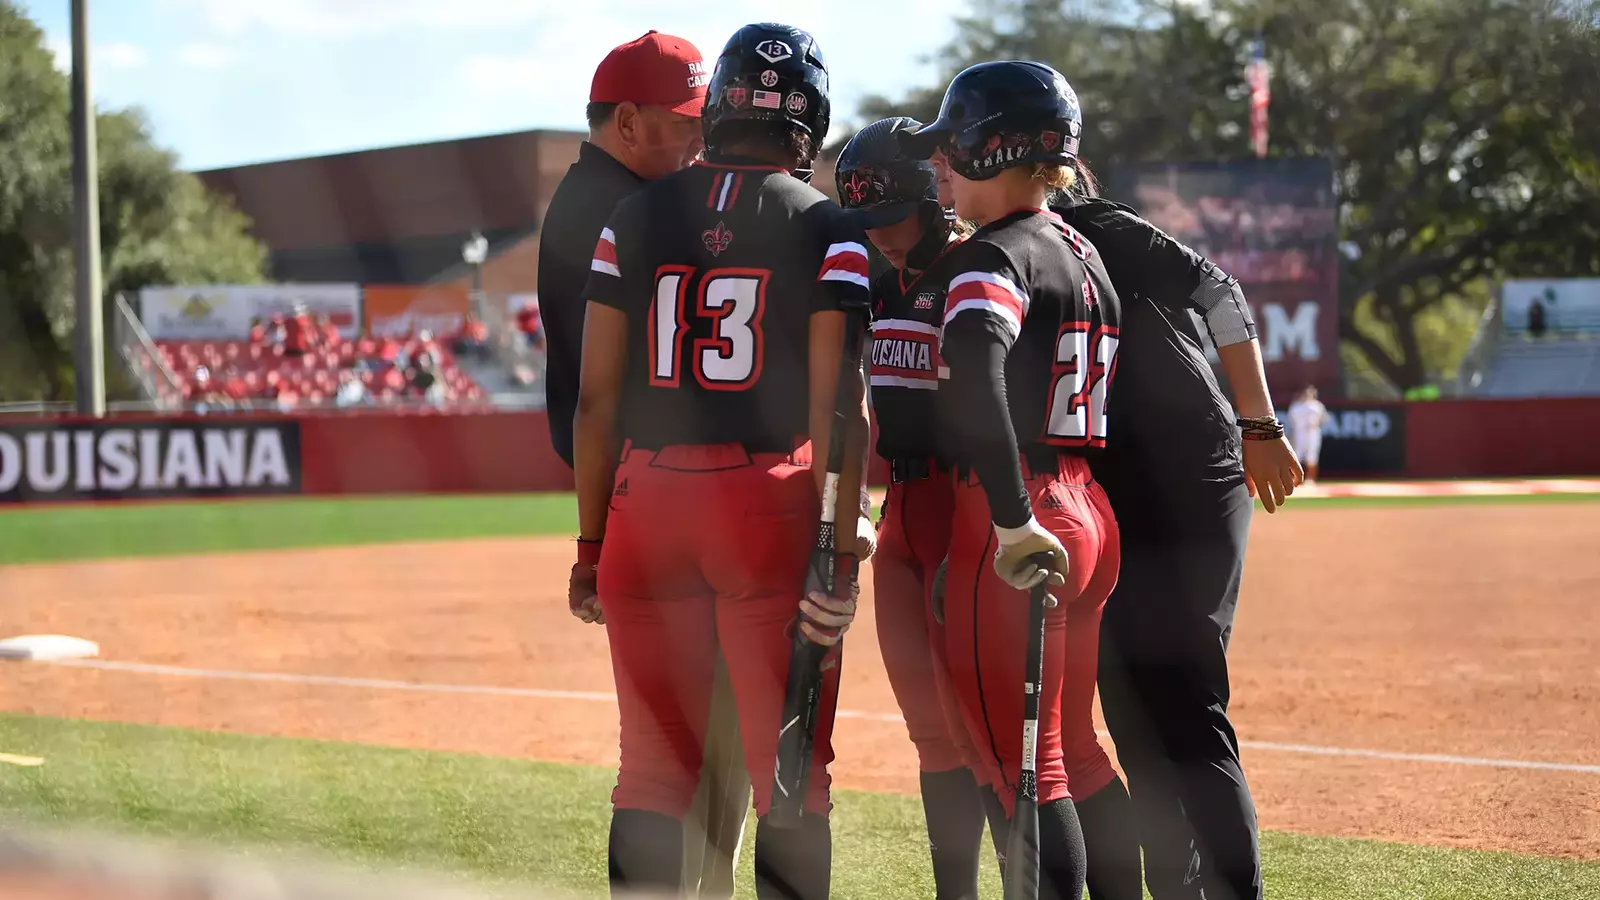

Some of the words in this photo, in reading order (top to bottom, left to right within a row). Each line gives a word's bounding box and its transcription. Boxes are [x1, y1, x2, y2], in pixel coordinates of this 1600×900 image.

[767, 44, 782, 56] 13
[688, 61, 706, 74] RA
[687, 75, 707, 88] CA
[647, 264, 773, 392] 13
[1038, 321, 1119, 447] 22
